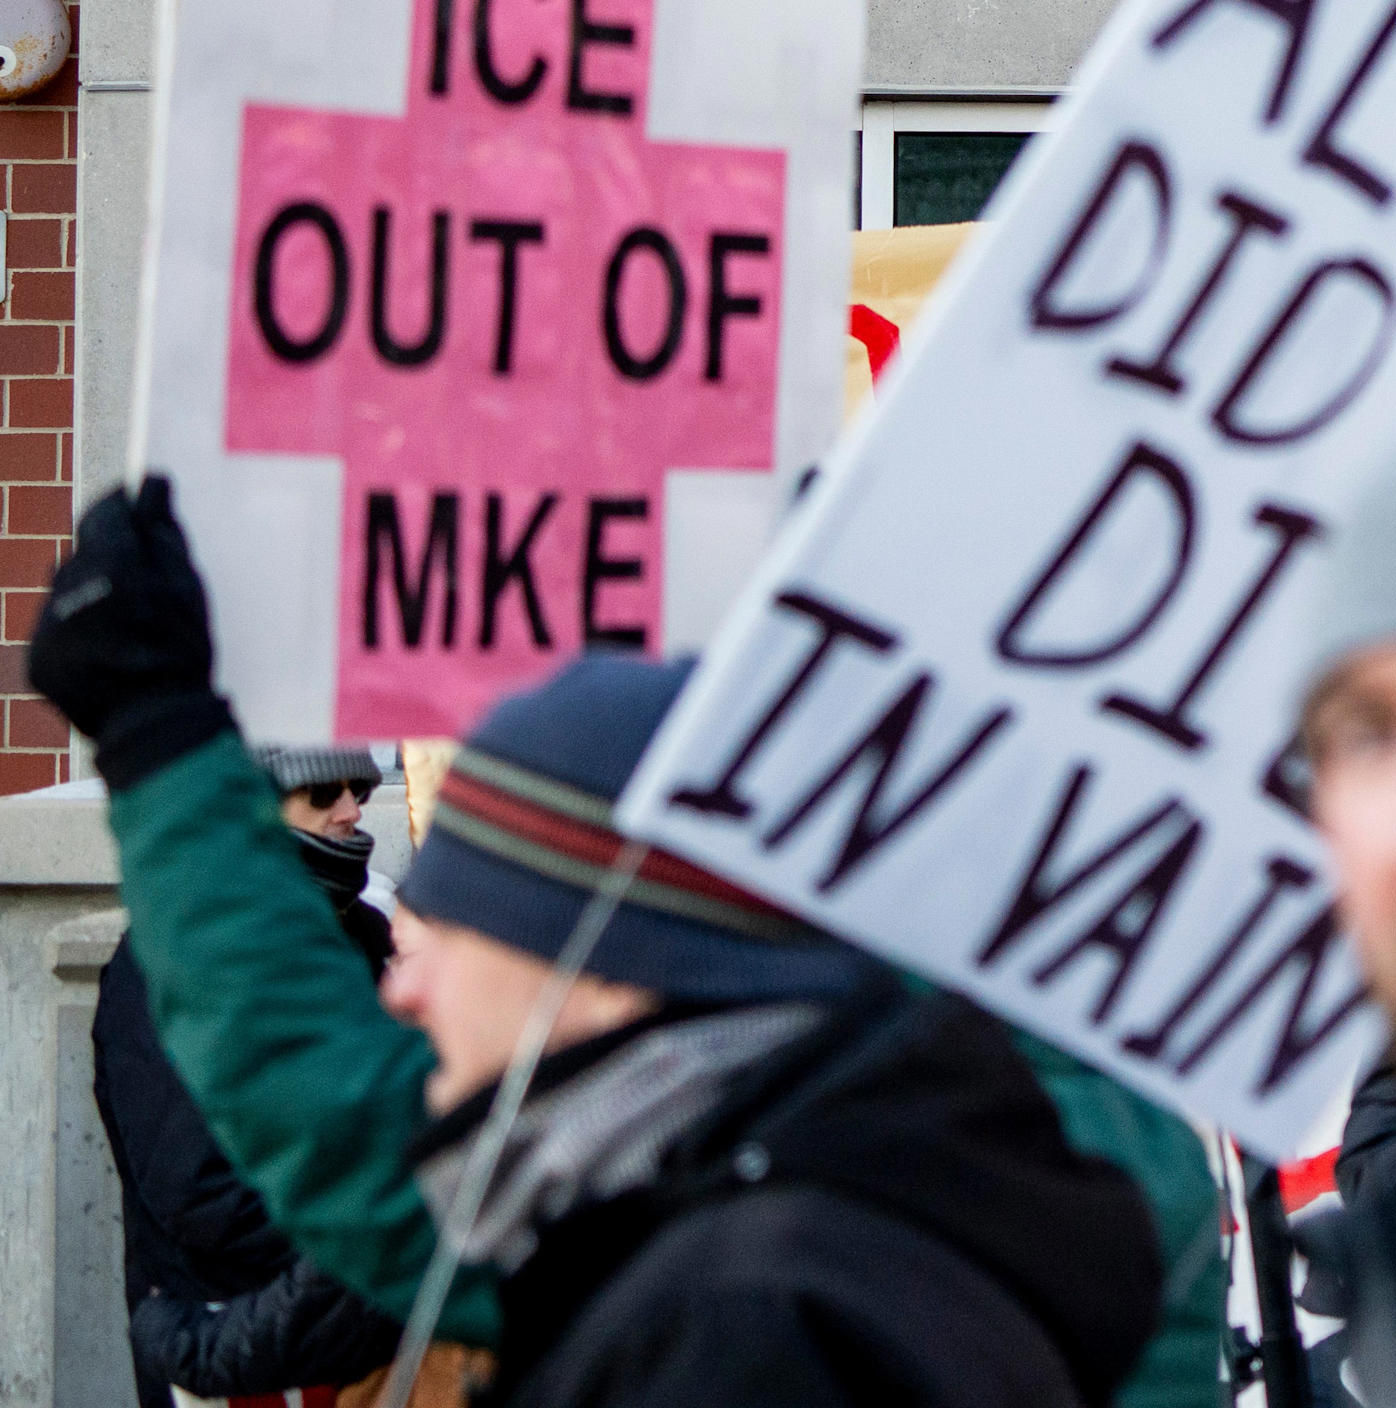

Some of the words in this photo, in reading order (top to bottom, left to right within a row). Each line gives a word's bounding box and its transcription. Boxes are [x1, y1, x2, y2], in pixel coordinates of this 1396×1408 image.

[251, 201, 546, 378] OUT
[602, 226, 772, 384] OF
[360, 488, 650, 653] MKE
[990, 437, 1316, 830] DI
[666, 589, 1019, 898] IN
[974, 760, 1374, 1100] VAIN
